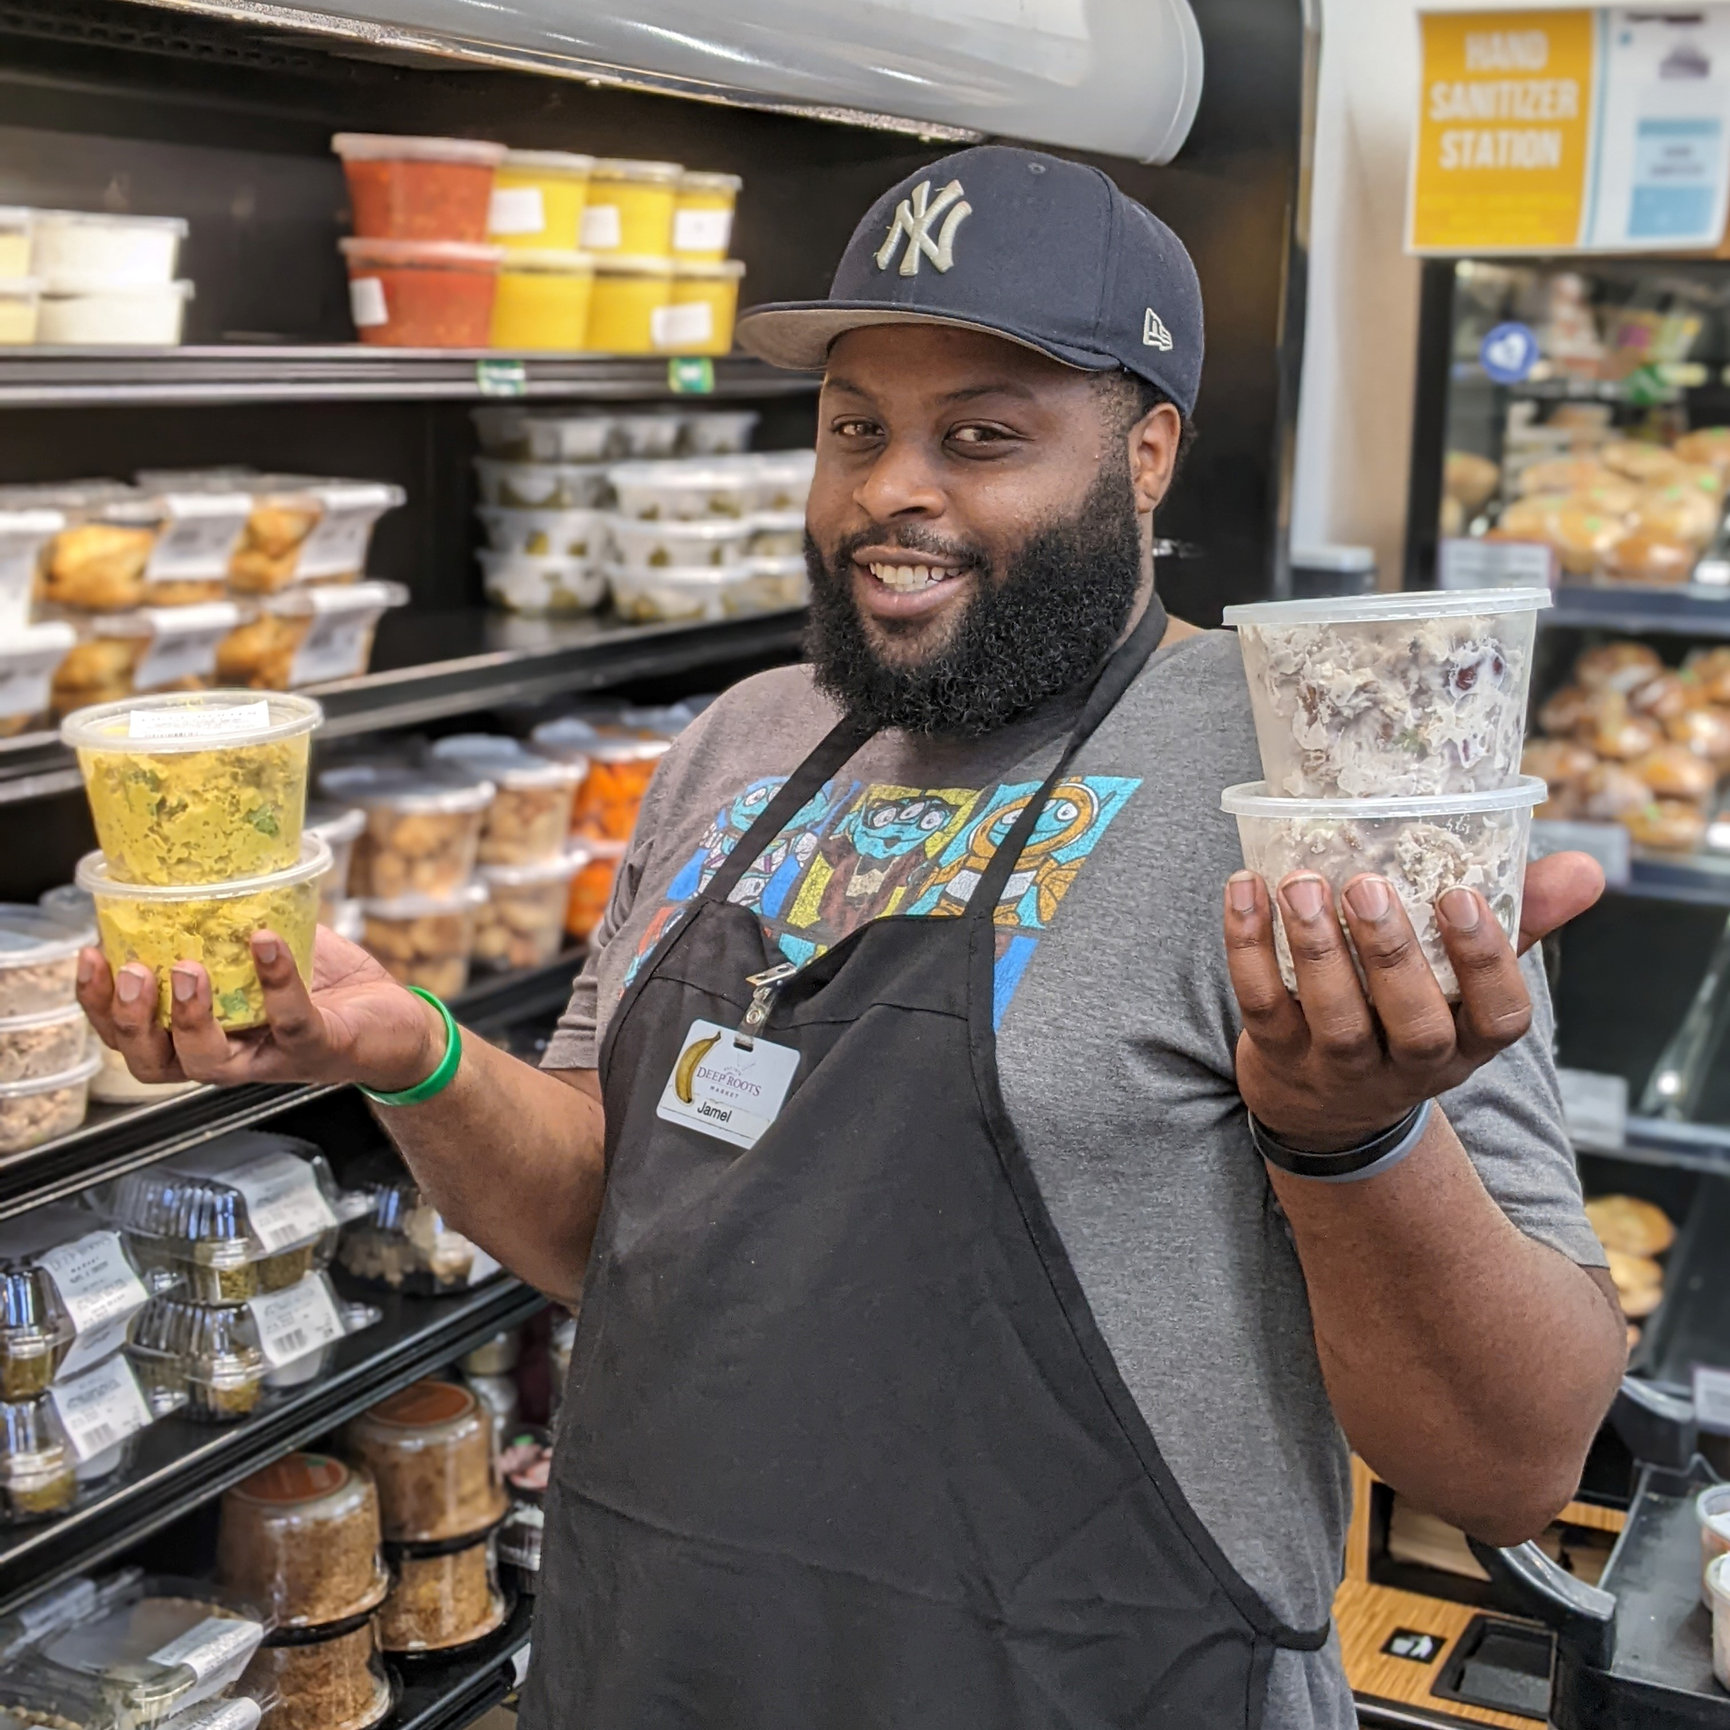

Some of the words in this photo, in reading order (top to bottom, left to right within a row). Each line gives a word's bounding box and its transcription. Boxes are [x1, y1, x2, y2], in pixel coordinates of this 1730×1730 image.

[1464, 29, 1549, 73] HAND
[1430, 77, 1580, 122] SANITIZER
[1439, 129, 1562, 170] STATION
[876, 179, 973, 276] NY
[696, 1066, 726, 1082] DEEP
[726, 1076, 762, 1097] ROOTS
[710, 1086, 740, 1099] MARKET
[697, 1101, 733, 1123] Jamel
